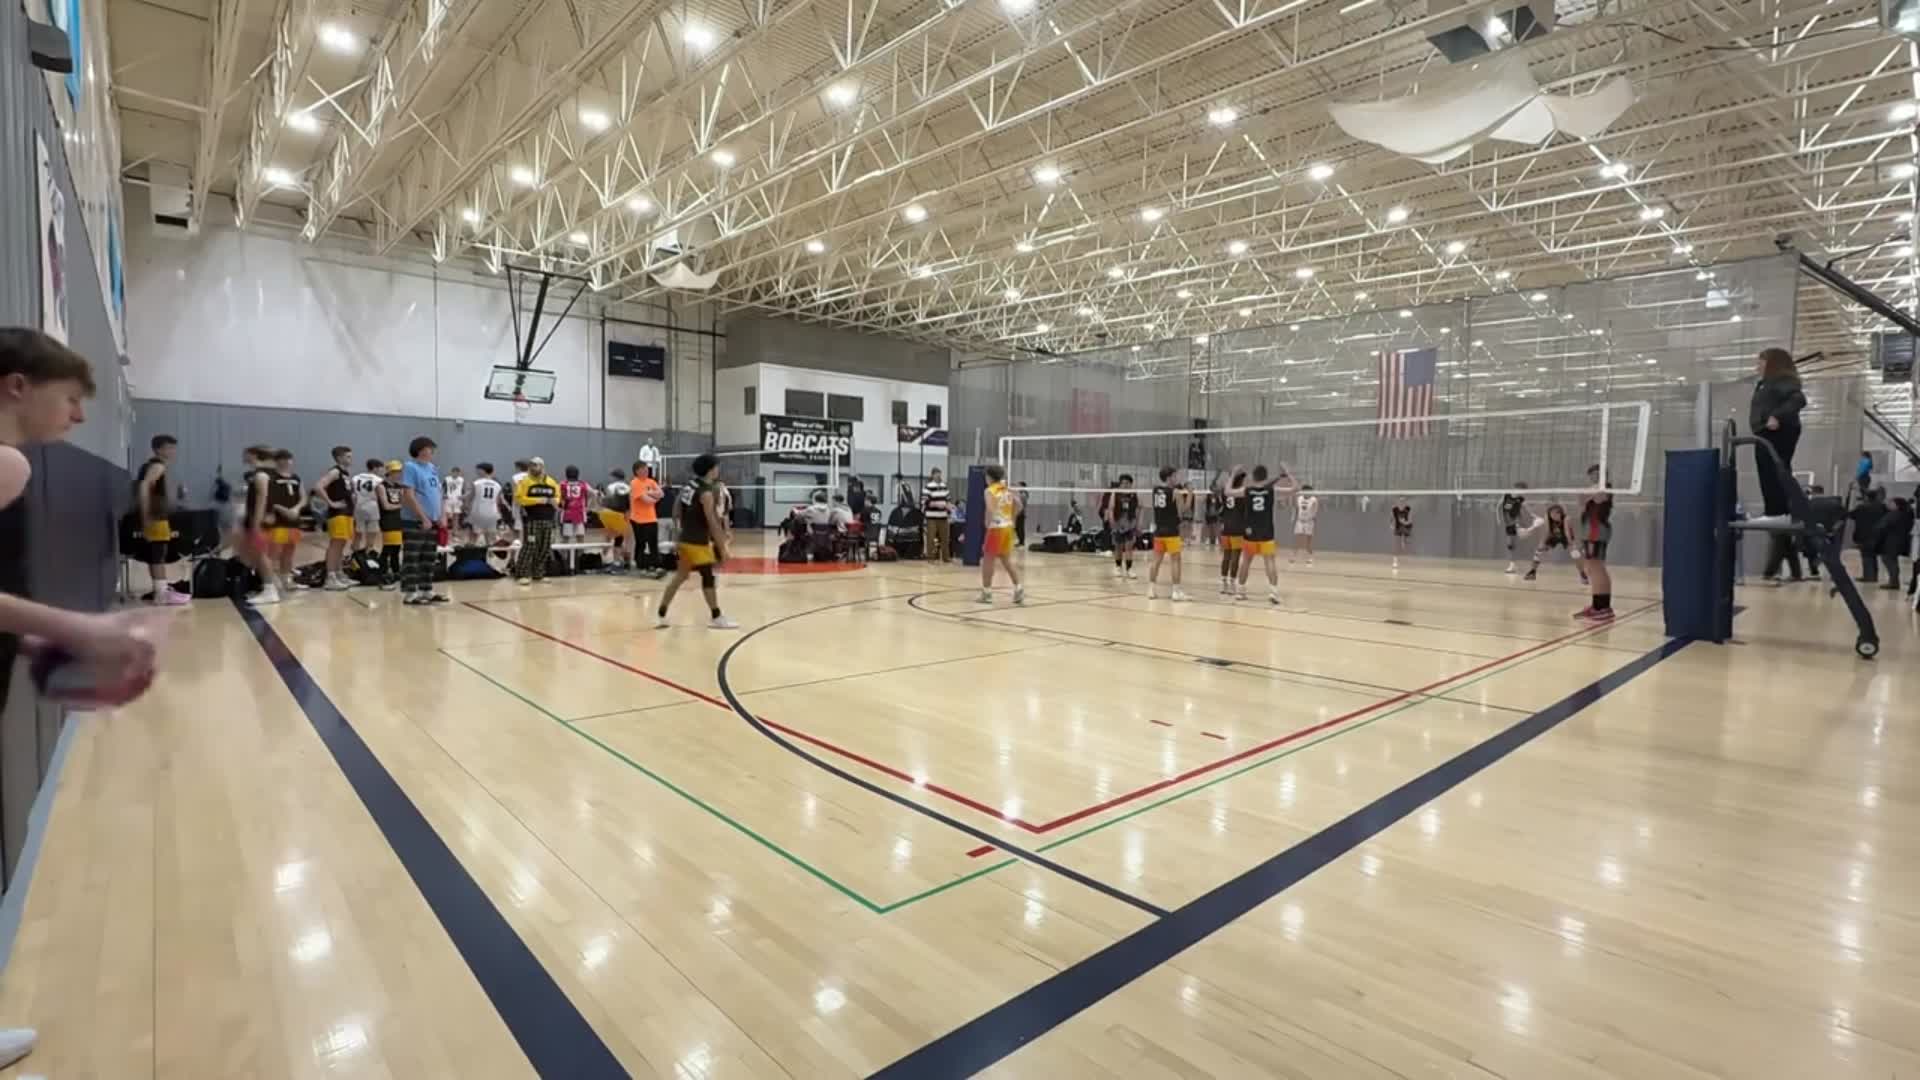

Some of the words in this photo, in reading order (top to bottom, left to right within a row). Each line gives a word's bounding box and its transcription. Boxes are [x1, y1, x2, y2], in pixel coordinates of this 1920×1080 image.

[764, 431, 850, 456] BOBCATS
[356, 479, 374, 493] 14
[483, 487, 495, 499] 11
[566, 485, 581, 498] 13
[1252, 496, 1265, 511] 2
